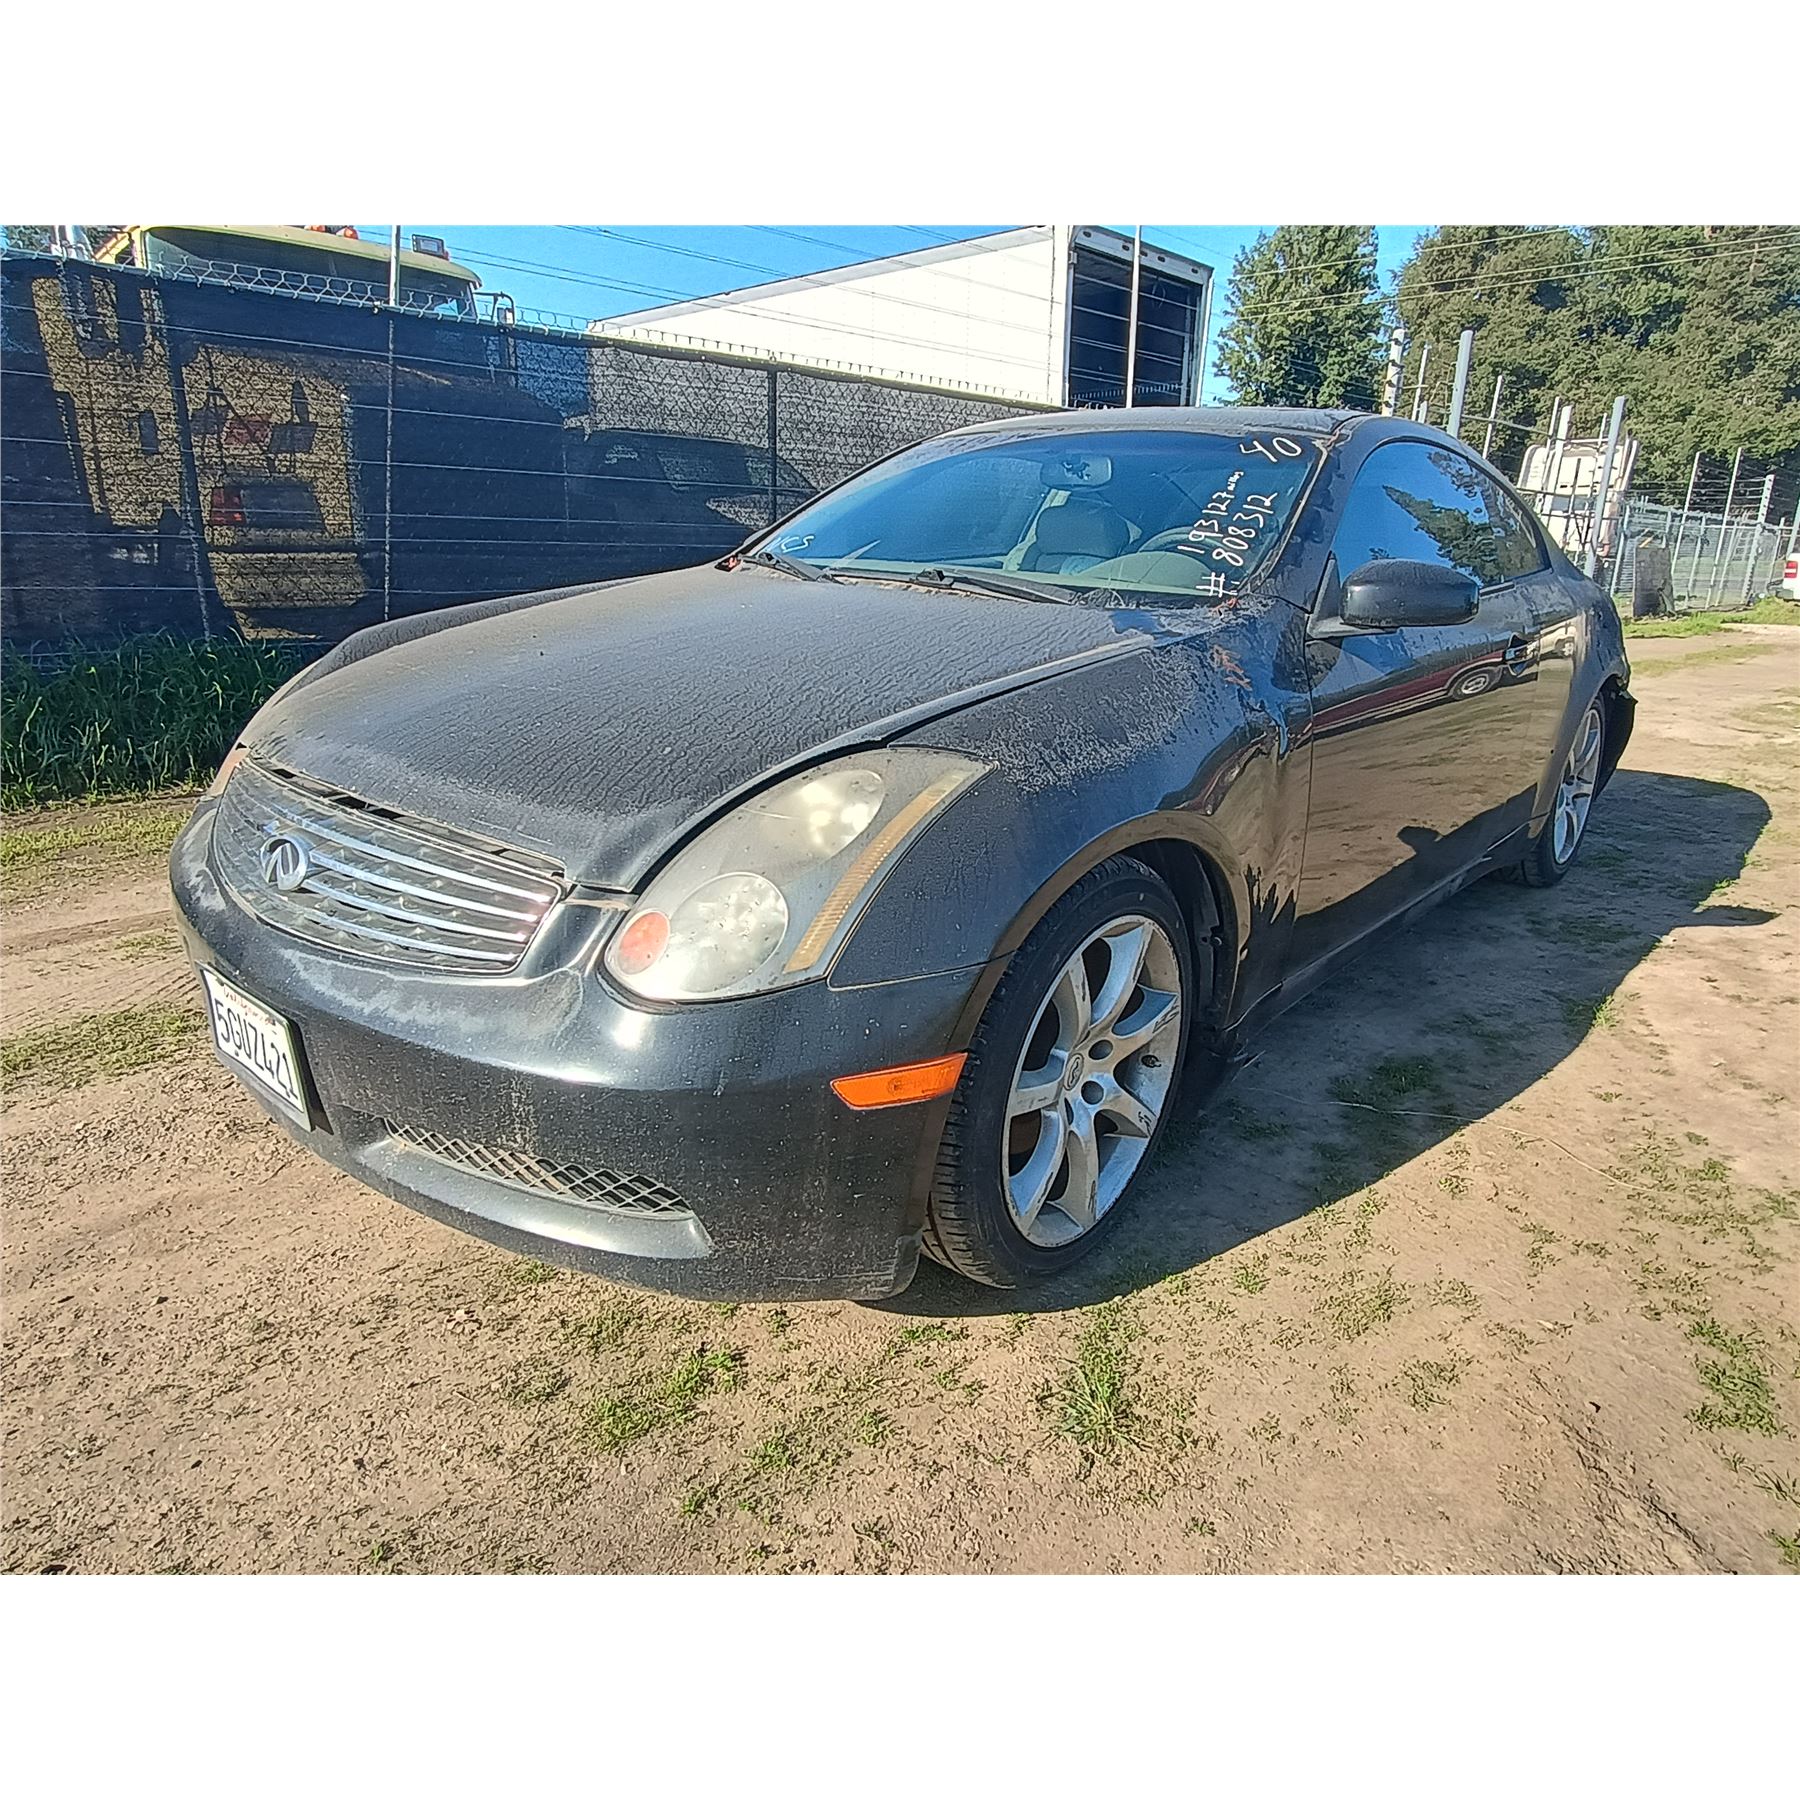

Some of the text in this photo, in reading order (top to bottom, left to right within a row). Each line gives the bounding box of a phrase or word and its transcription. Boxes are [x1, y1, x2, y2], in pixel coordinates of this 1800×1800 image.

[1239, 437, 1302, 463] 40
[1177, 491, 1235, 554] 193127
[214, 998, 299, 1100] 5GUZ421
